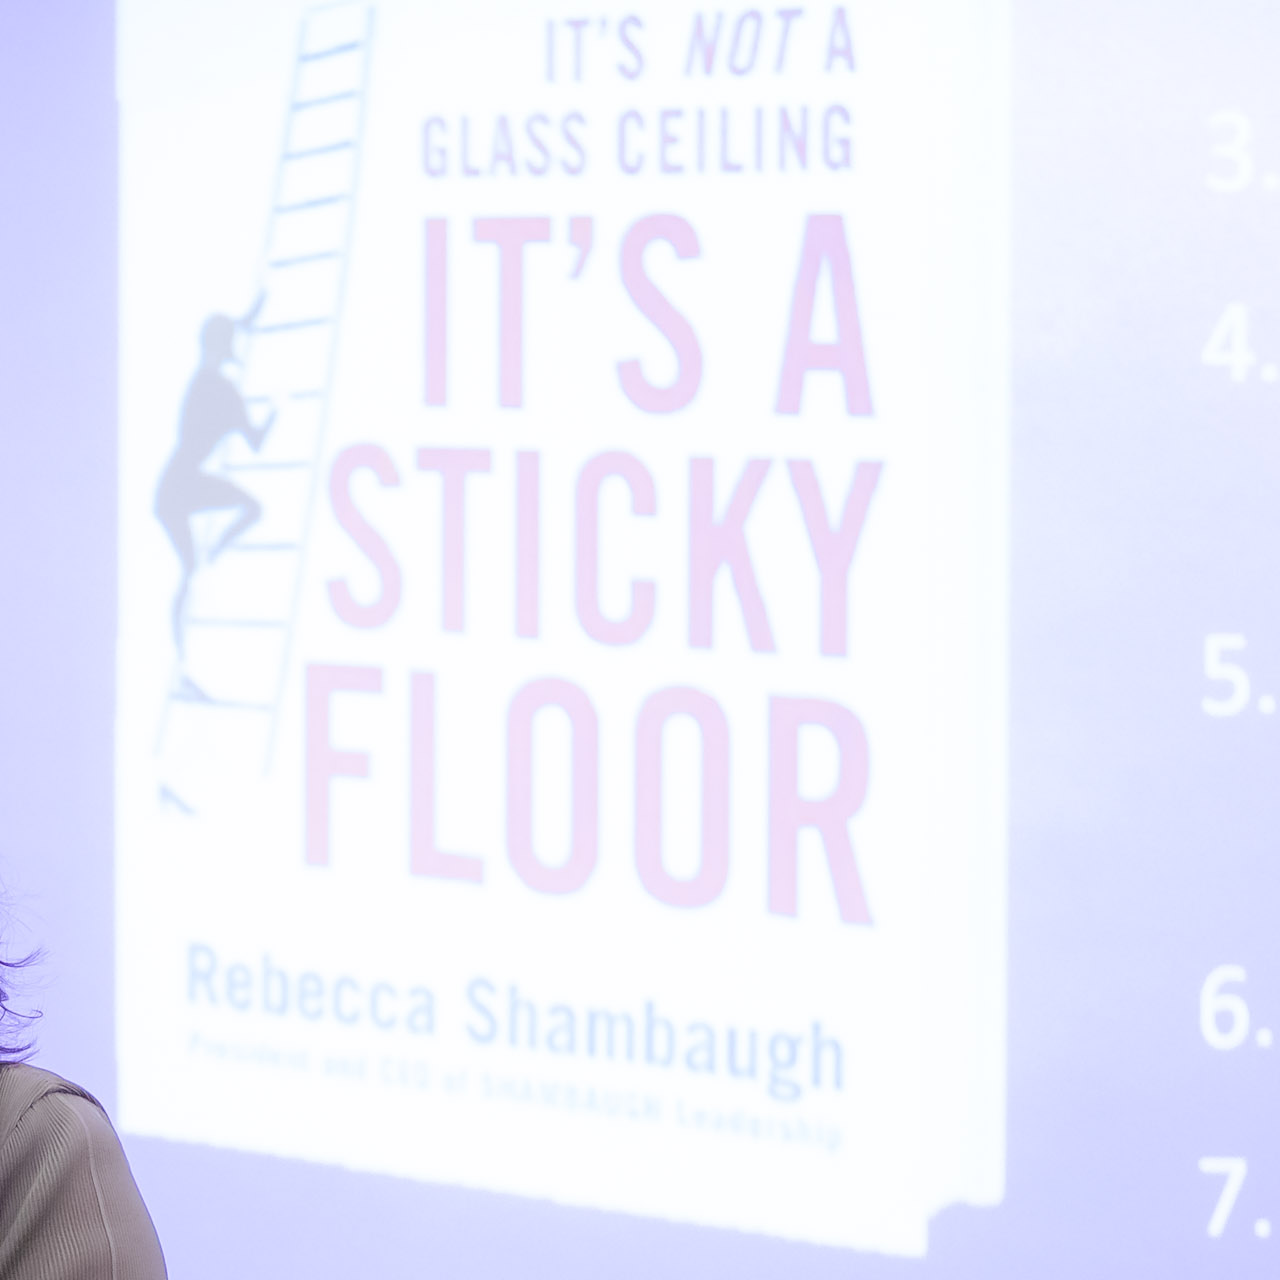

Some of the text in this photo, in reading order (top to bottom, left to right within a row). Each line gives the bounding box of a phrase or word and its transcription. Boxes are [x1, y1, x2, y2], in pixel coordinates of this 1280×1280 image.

[545, 5, 858, 83] IT'S NOT A
[421, 102, 855, 178] GLASS CEILING
[423, 212, 876, 418] IT'S A
[1199, 300, 1279, 384] 4.
[325, 441, 885, 659] STICKY
[1200, 632, 1277, 718] 5.
[303, 661, 877, 929] FLOOR
[184, 940, 846, 1103] Rebecca Shambaugh
[1199, 963, 1275, 1050] 6.
[1198, 1156, 1272, 1239] 7.
